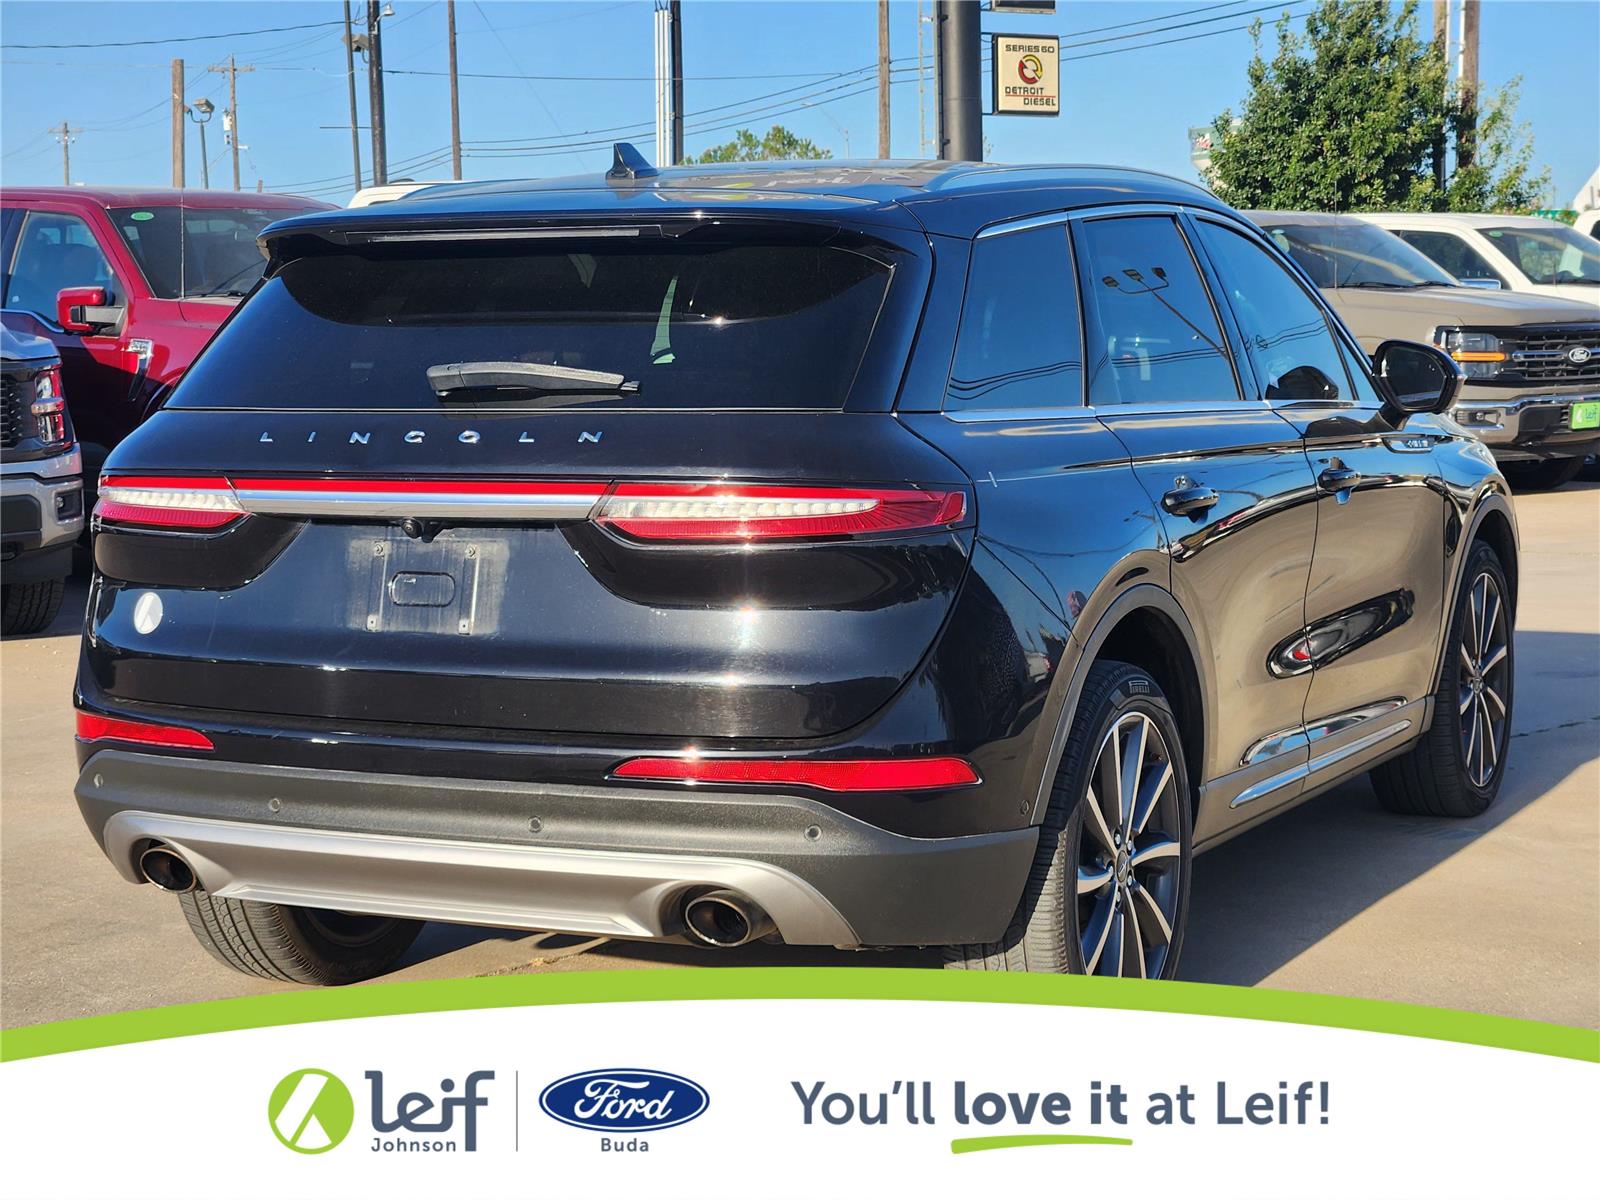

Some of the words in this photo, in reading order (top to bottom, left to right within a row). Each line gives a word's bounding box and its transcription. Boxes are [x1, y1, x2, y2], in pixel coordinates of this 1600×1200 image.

[1005, 44, 1040, 53] SERIES
[1005, 86, 1044, 95] DETROIT
[1023, 97, 1056, 106] DIESEL
[259, 430, 603, 445] LINCOLN
[1128, 680, 1150, 694] PIRELLI
